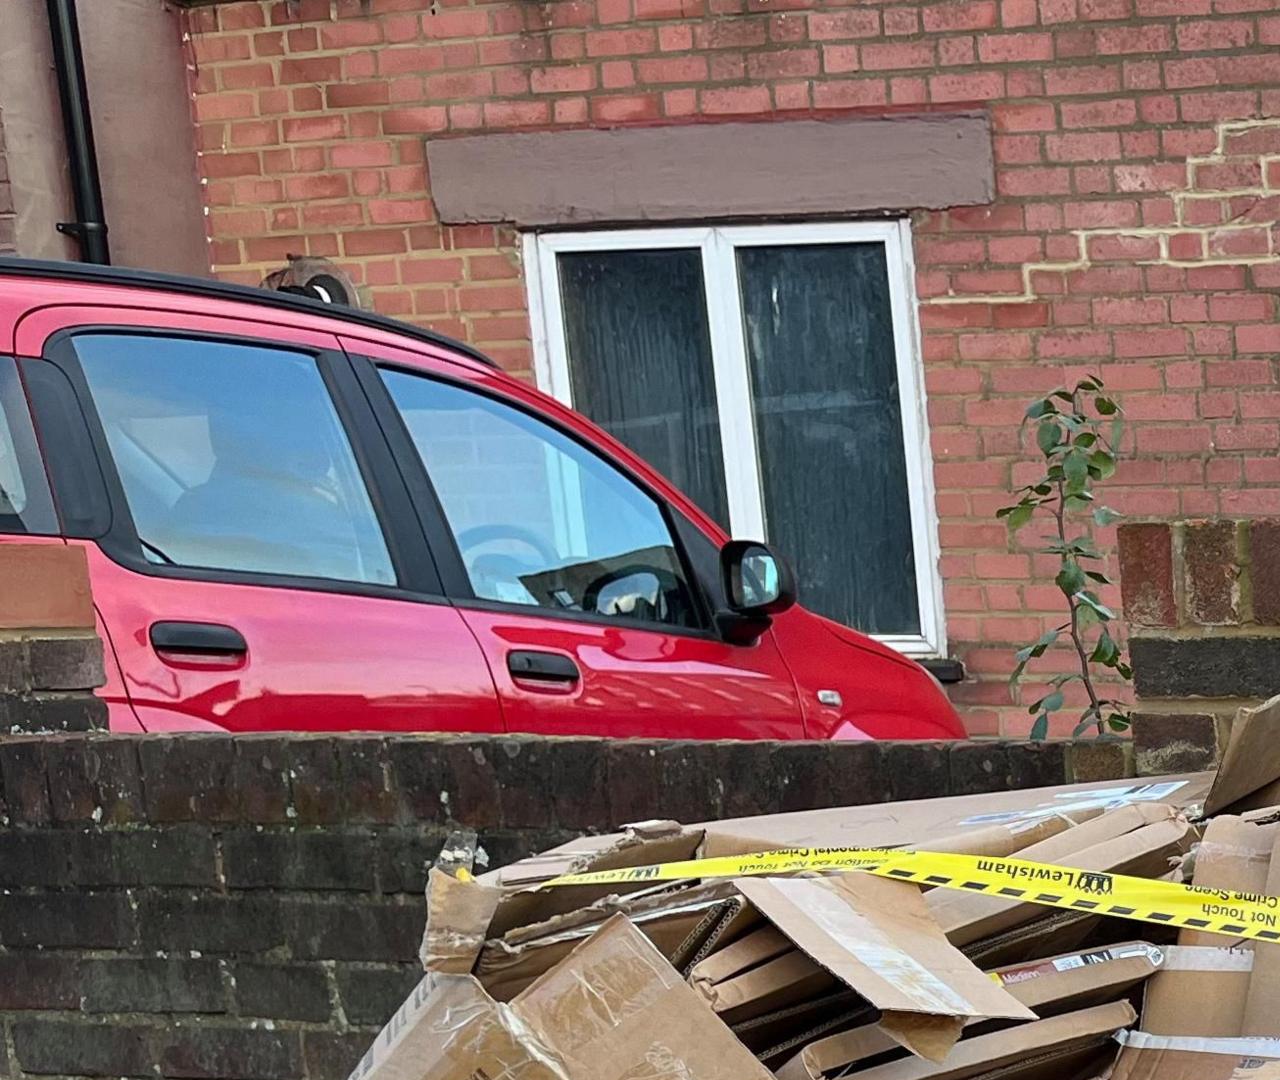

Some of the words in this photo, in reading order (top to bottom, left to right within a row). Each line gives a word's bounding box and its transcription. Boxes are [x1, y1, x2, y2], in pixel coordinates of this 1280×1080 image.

[974, 858, 1073, 887] Lewisham
[1233, 890, 1277, 908] Crime
[1200, 902, 1247, 922] Touch
[1249, 909, 1276, 926] Not
